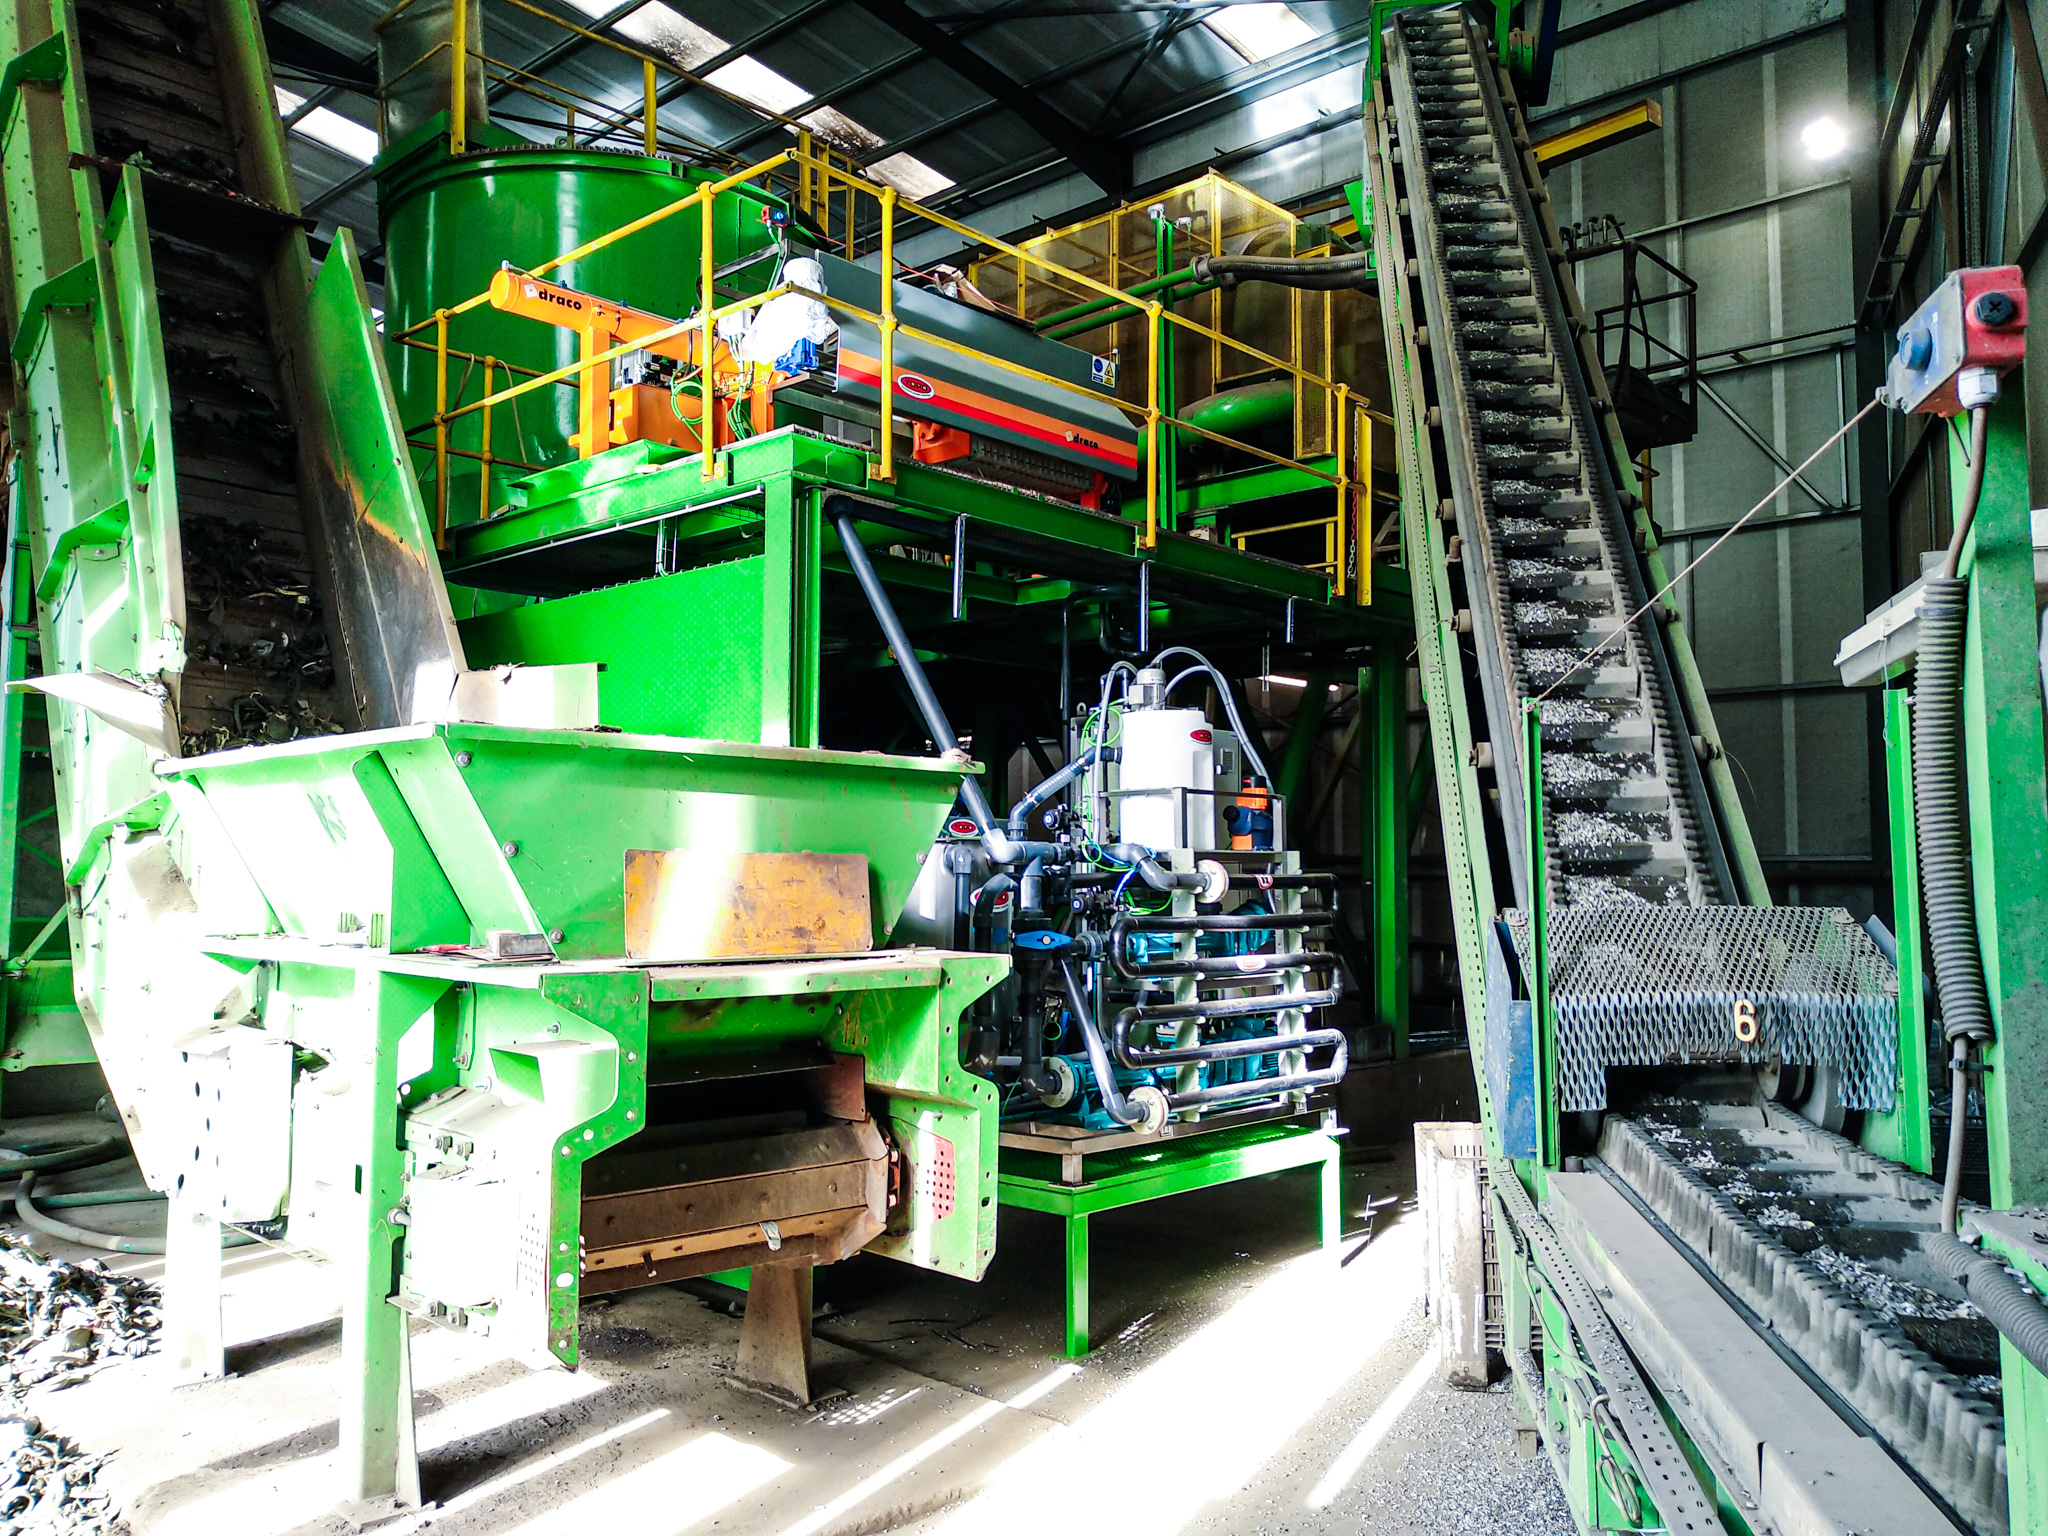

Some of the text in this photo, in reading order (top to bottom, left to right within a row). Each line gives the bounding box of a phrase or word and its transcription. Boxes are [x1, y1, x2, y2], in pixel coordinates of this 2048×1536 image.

[539, 288, 582, 310] draco
[1073, 433, 1099, 449] draco
[1734, 999, 1756, 1042] 6
